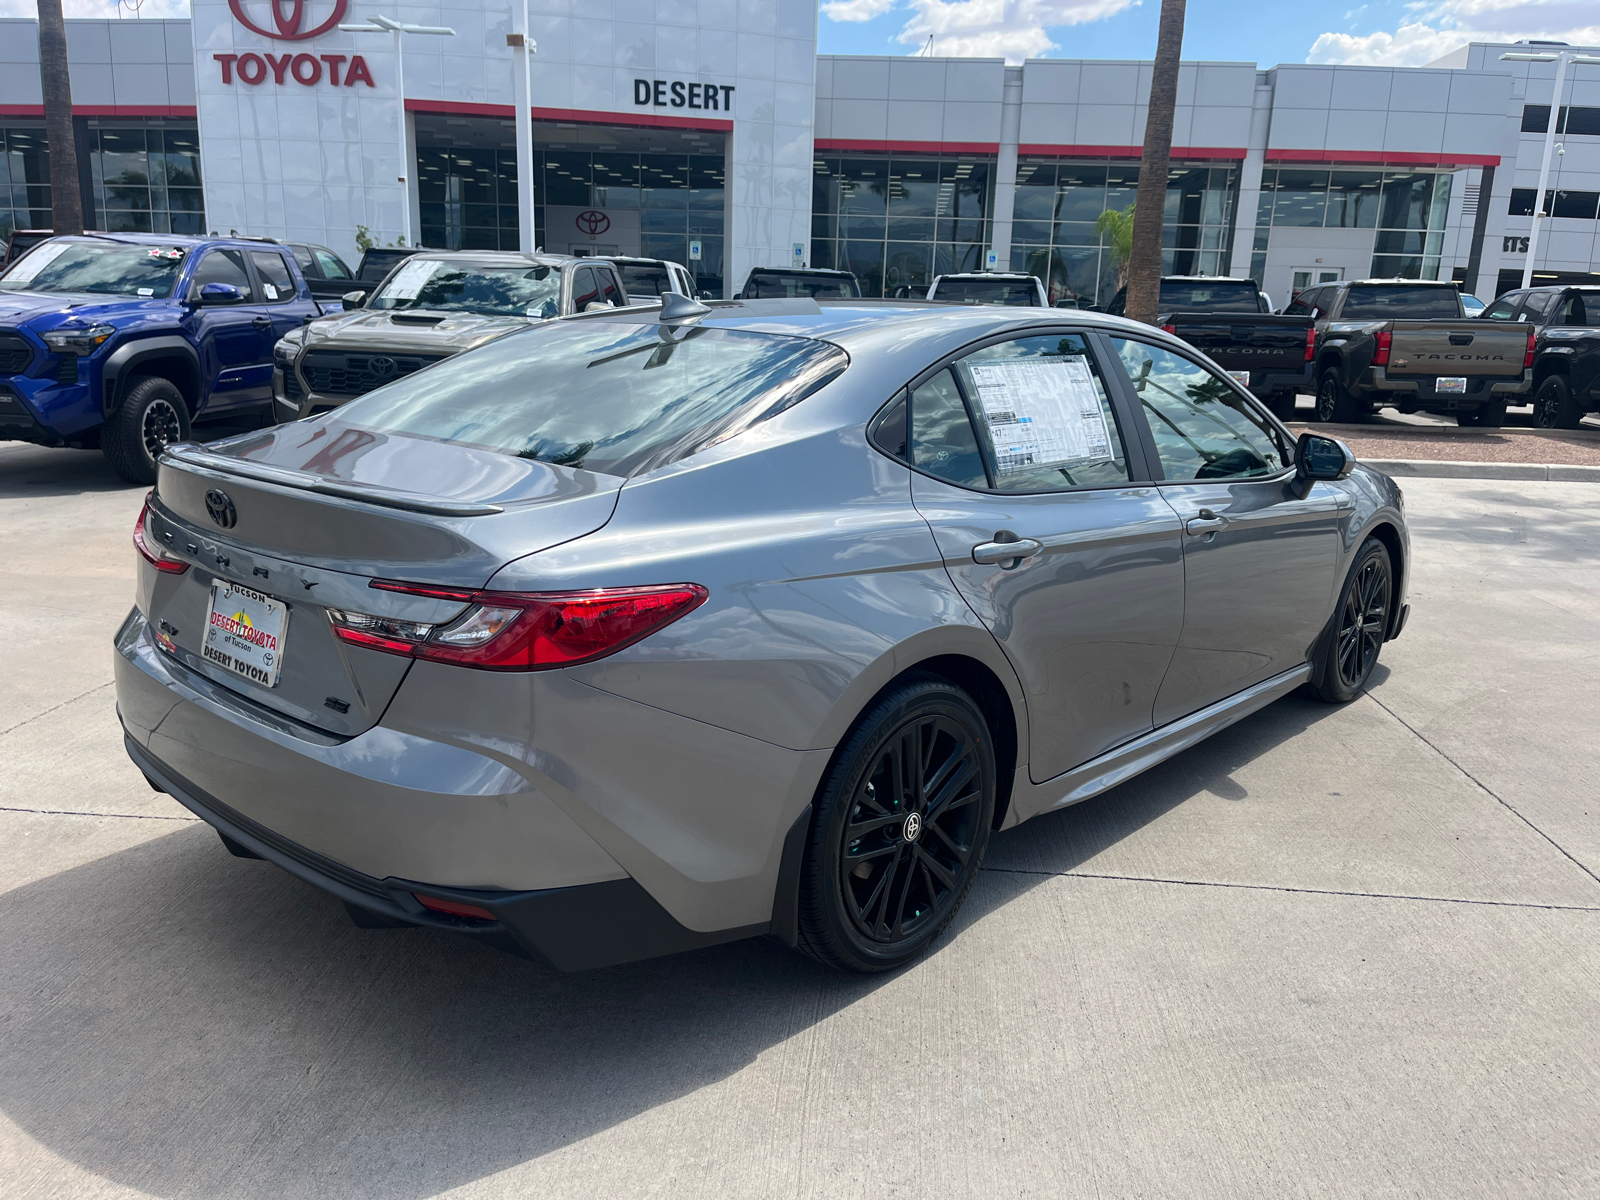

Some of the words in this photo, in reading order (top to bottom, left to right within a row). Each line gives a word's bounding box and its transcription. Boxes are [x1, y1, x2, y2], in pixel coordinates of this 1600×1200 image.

[213, 52, 376, 88] TOYOTA
[634, 78, 736, 112] DESERT
[1198, 347, 1285, 355] TACOMA
[1412, 353, 1505, 361] TACOMA
[229, 583, 267, 603] TUCSON
[211, 611, 242, 635] DESERT
[241, 623, 277, 651] TOYOTA
[224, 635, 232, 643] of
[231, 636, 252, 653] Tucson
[203, 644, 234, 668] DESERT
[233, 658, 270, 685] TOYOTA
